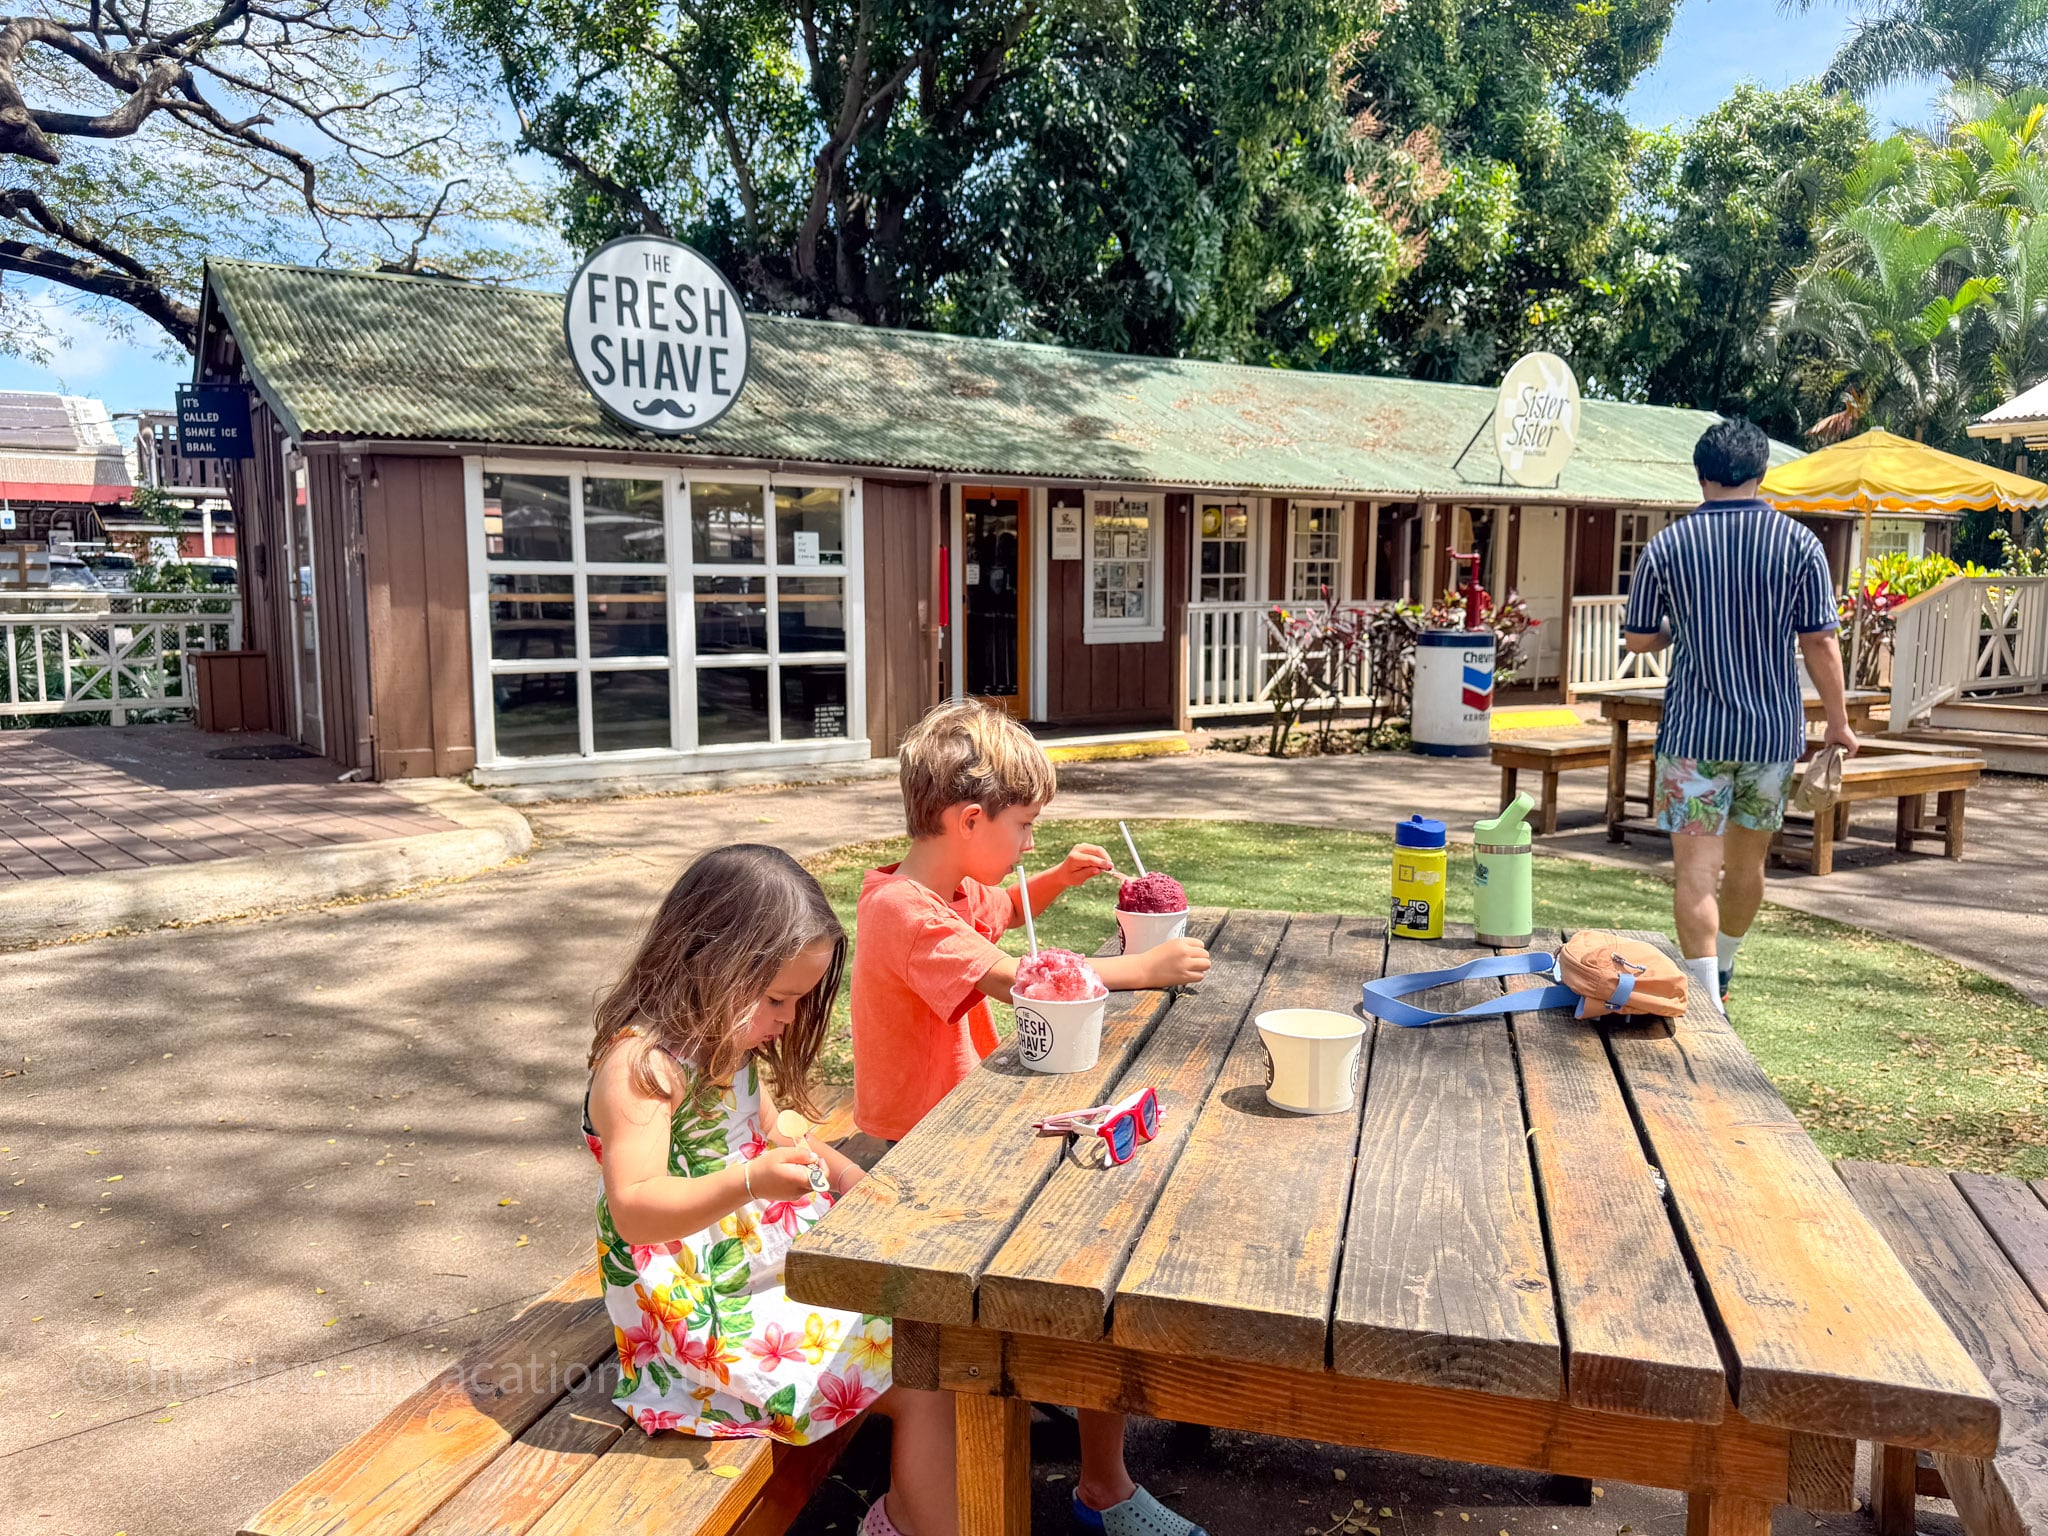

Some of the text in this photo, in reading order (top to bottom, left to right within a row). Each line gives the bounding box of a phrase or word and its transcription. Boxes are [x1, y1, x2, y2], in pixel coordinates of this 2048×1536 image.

[642, 253, 671, 274] THE
[587, 272, 728, 339] FRESH
[591, 334, 731, 396] SHAVE
[182, 397, 200, 408] IT'S
[1516, 386, 1570, 420] Sister
[183, 412, 220, 423] CALLED
[184, 427, 238, 438] SHAVE ICE
[1506, 413, 1560, 448] Sister
[185, 442, 217, 452] BRAH.
